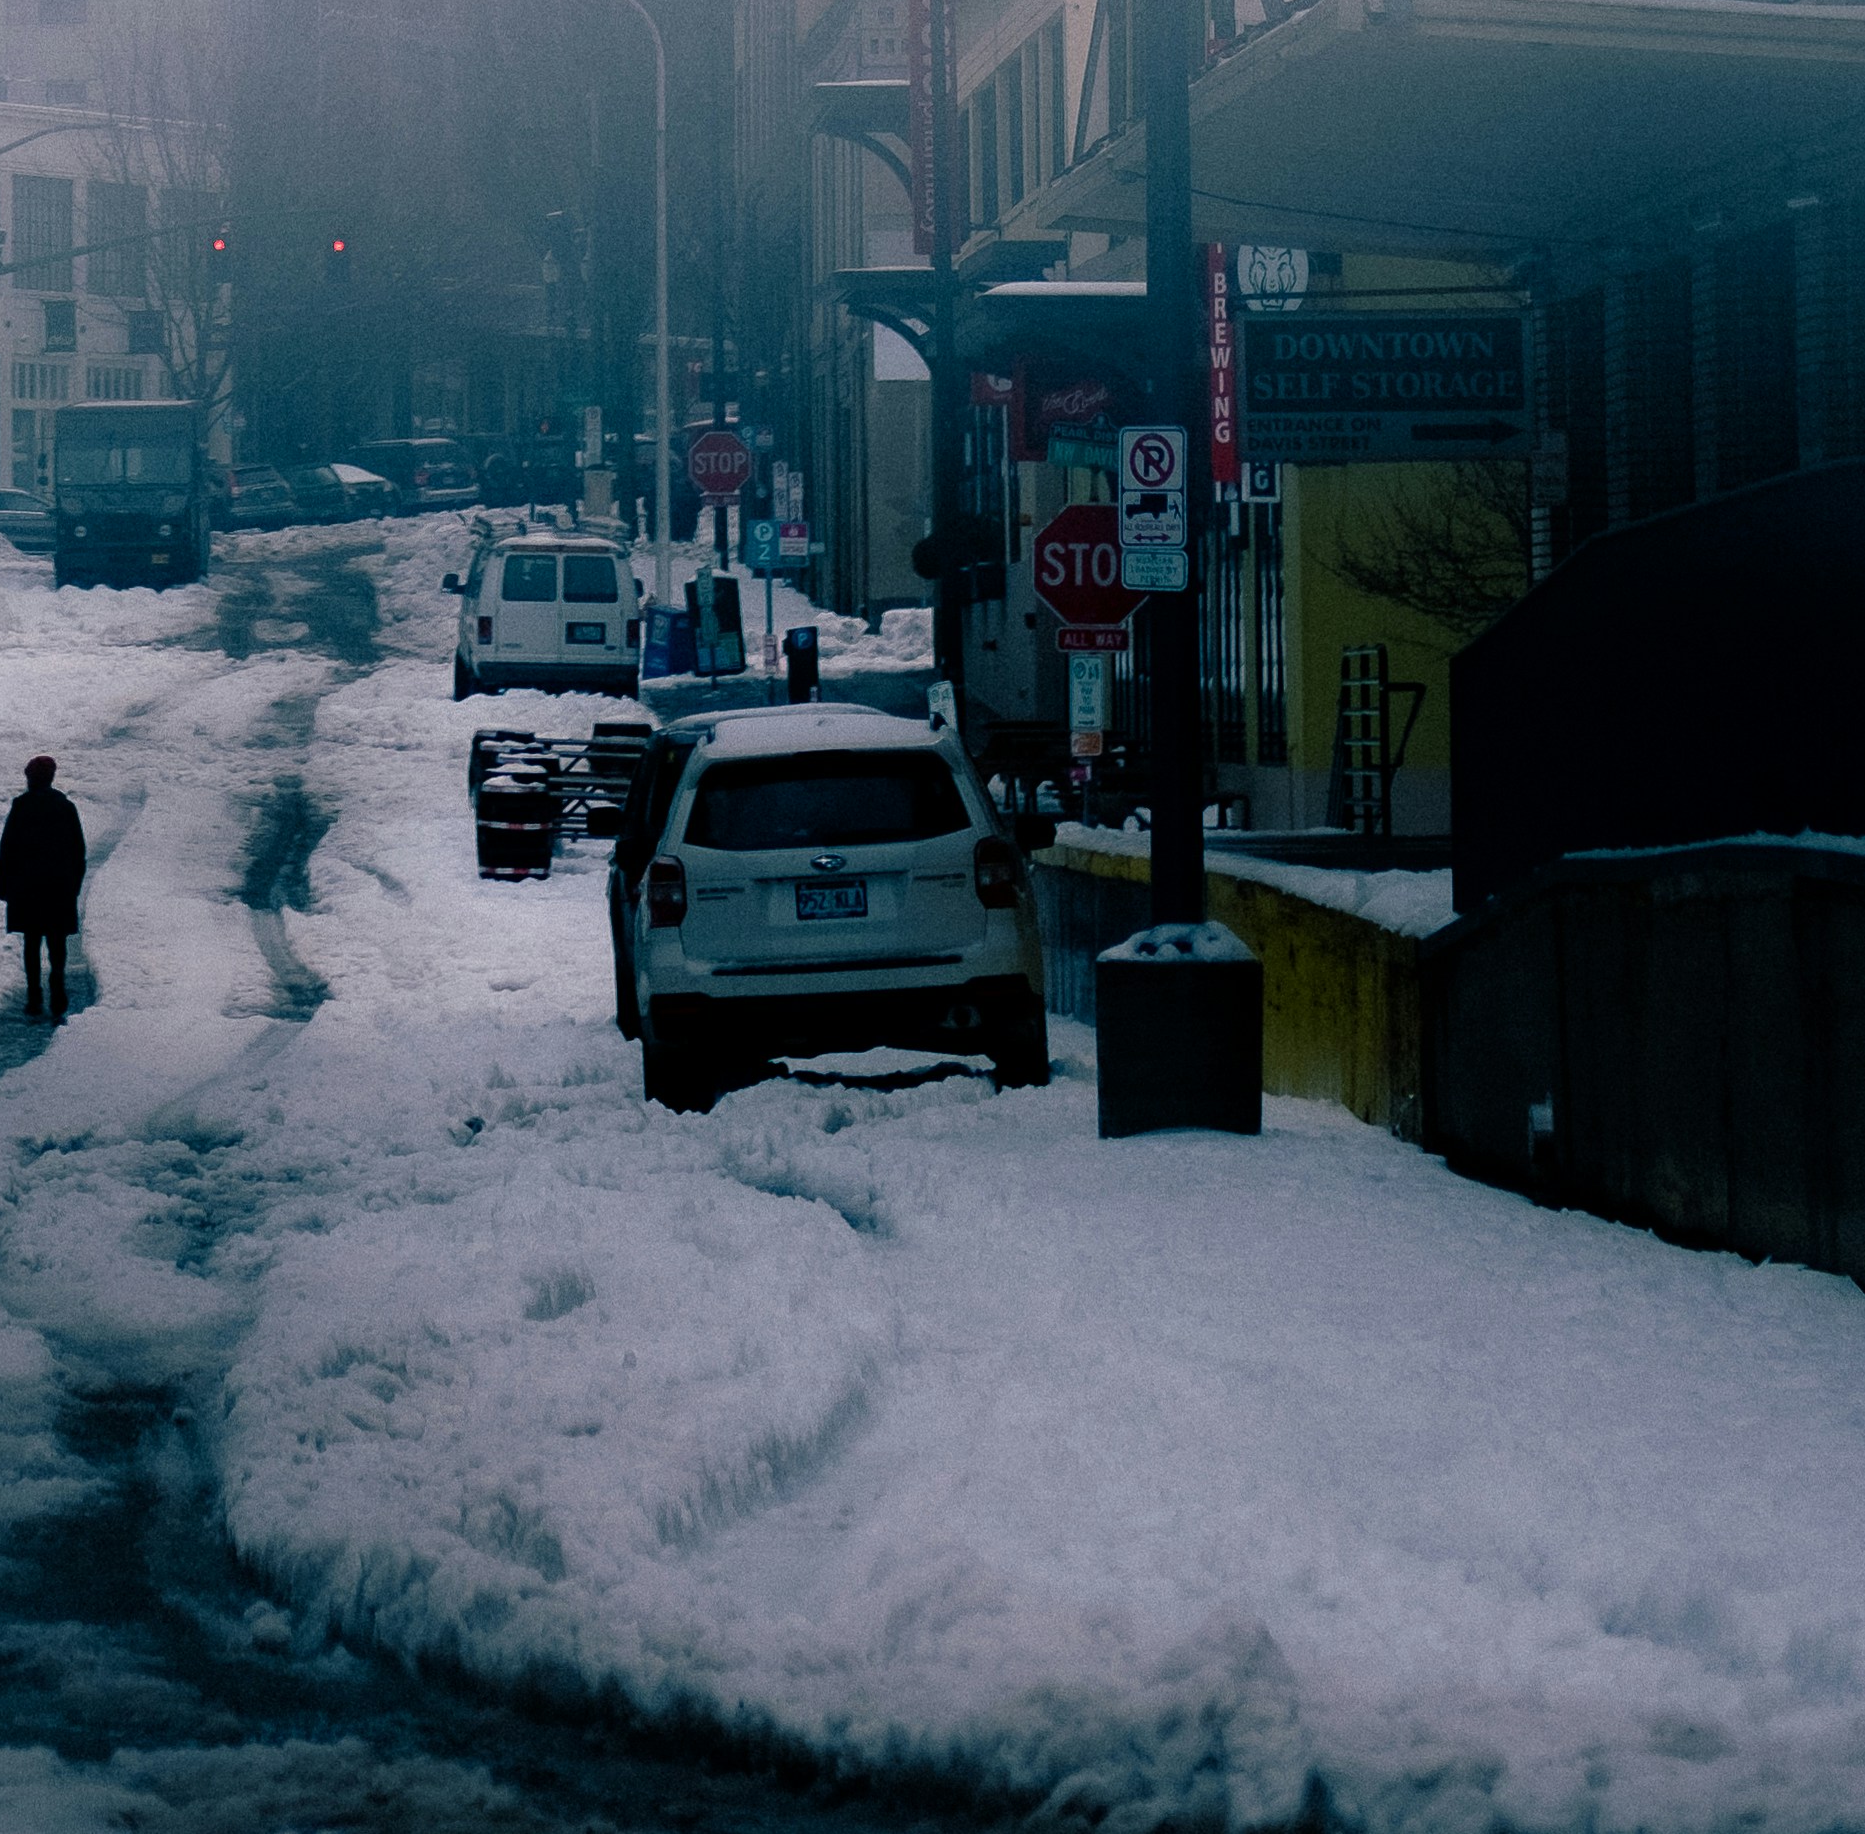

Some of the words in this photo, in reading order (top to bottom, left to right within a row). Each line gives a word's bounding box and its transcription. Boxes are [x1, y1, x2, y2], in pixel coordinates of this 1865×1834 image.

[1210, 272, 1231, 443] BREWING
[1273, 332, 1496, 361] DOWNTOWN
[1253, 372, 1341, 400] SELF
[1351, 371, 1518, 400] STORAGE
[1053, 425, 1091, 440] PEARL
[1093, 429, 1119, 443] DIST
[1247, 417, 1344, 433] ENTRANCE
[1350, 417, 1382, 432] ON
[1248, 436, 1303, 451] DAVIS
[1308, 435, 1371, 451] STREET
[694, 451, 747, 474] STOP
[1041, 541, 1118, 588] STO
[1063, 633, 1090, 647] ALL
[1094, 633, 1124, 647] WAY
